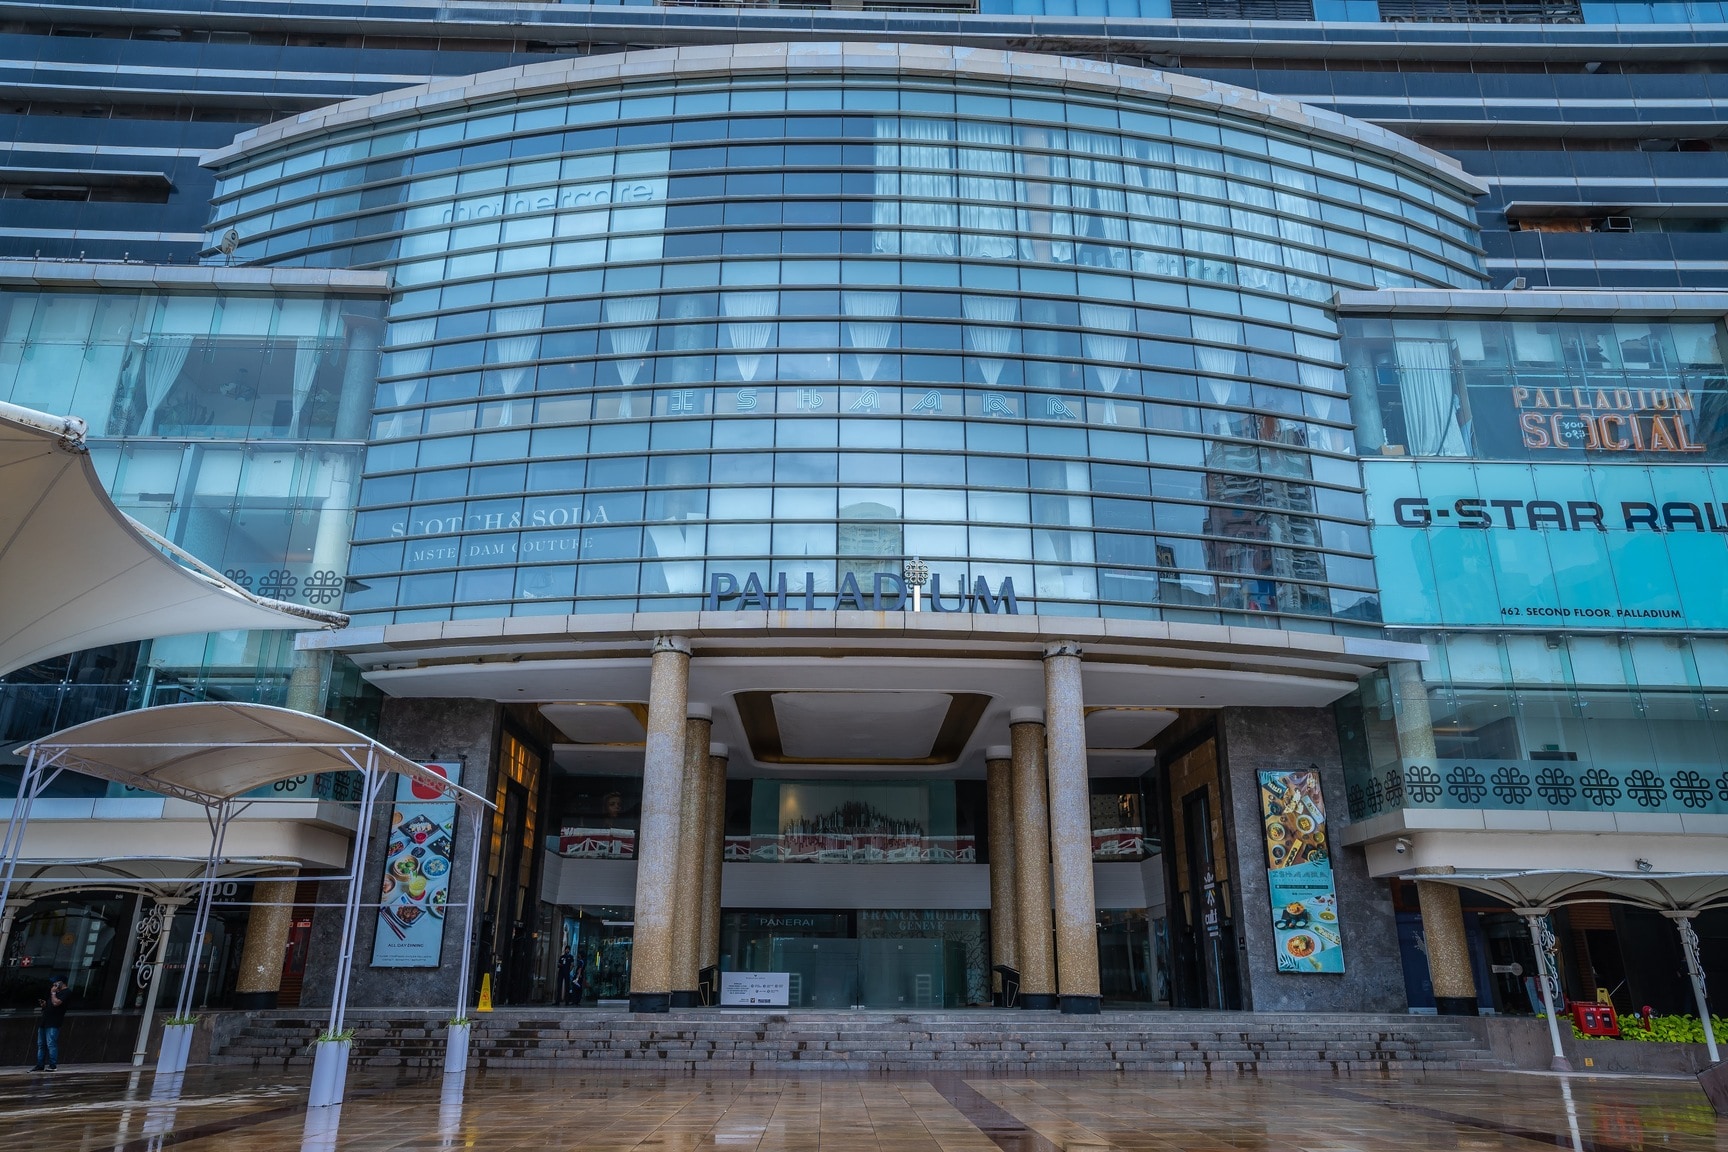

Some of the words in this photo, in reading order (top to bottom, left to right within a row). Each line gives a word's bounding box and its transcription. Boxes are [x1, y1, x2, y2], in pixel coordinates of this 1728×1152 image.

[1512, 386, 1694, 411] PALLADIUM
[508, 511, 522, 529] &
[531, 505, 611, 528] SODA
[1393, 497, 1607, 531] G-STAR
[710, 560, 1019, 615] PALLADIUM
[1526, 607, 1571, 617] SECOND
[759, 918, 814, 927] PANERAI
[861, 910, 920, 921] FRANCK
